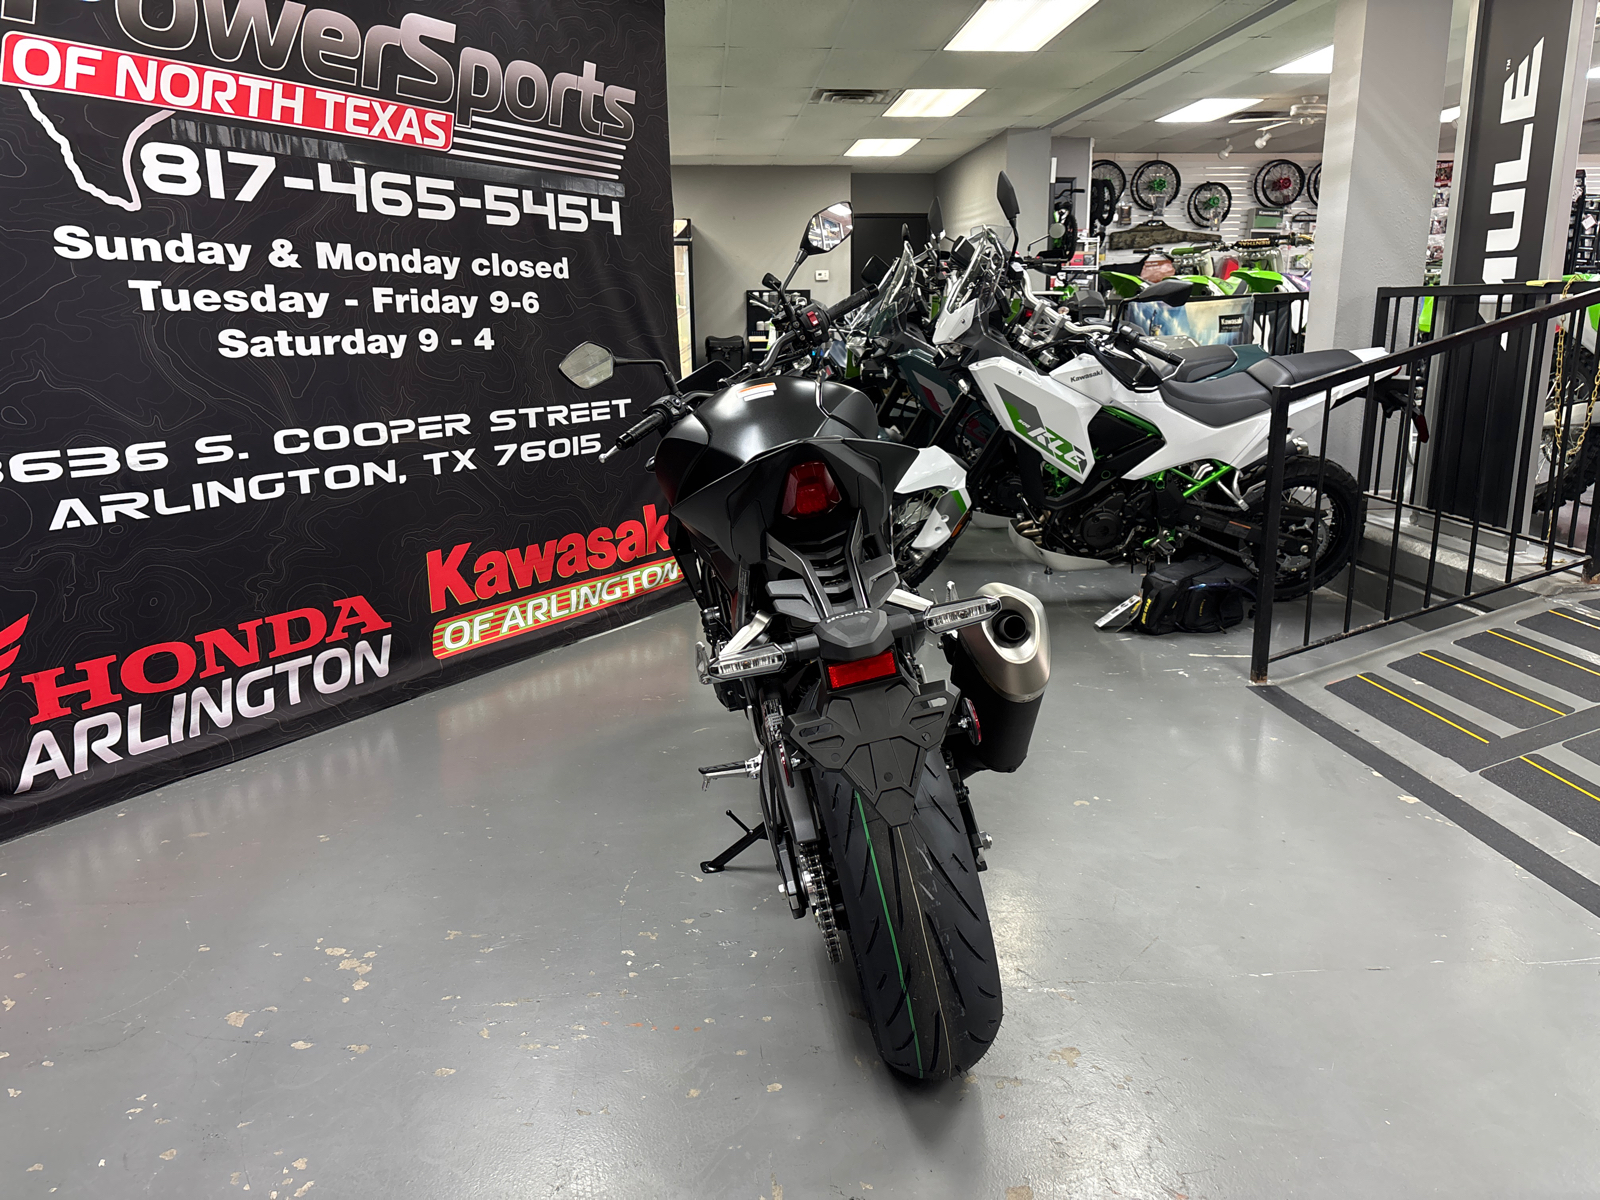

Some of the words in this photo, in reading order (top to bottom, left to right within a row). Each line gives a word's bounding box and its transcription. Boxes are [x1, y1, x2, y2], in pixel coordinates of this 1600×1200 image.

[1, 0, 636, 141] owerSports
[12, 38, 102, 89] OF
[115, 55, 304, 124] NORTH
[315, 90, 446, 148] TEXAS
[140, 142, 622, 236] 817-465-5454
[53, 225, 251, 270] Sunday
[268, 238, 301, 269] &
[316, 242, 460, 280] Monday
[471, 254, 570, 279] closed
[128, 279, 330, 318] Tuesday
[372, 287, 478, 316] Friday
[489, 291, 540, 315] 9-6
[217, 328, 407, 358] Saturday
[418, 328, 439, 353] 9
[474, 327, 496, 352] 4
[1070, 370, 1104, 383] Kawasaki
[0, 441, 169, 484] 636
[195, 434, 249, 465] S.
[273, 413, 471, 456] COOPER
[490, 398, 632, 432] STREET
[49, 460, 407, 531] ARLINGTON,
[423, 447, 477, 476] TX
[495, 433, 602, 466] 76015
[1027, 427, 1087, 466] KLE
[426, 503, 671, 614] Kawasak
[444, 611, 494, 649] OF
[500, 561, 678, 633] ARLINGTON
[826, 609, 874, 623] HONDA
[21, 595, 392, 725] HONDA
[13, 634, 392, 795] ARLINGTON
